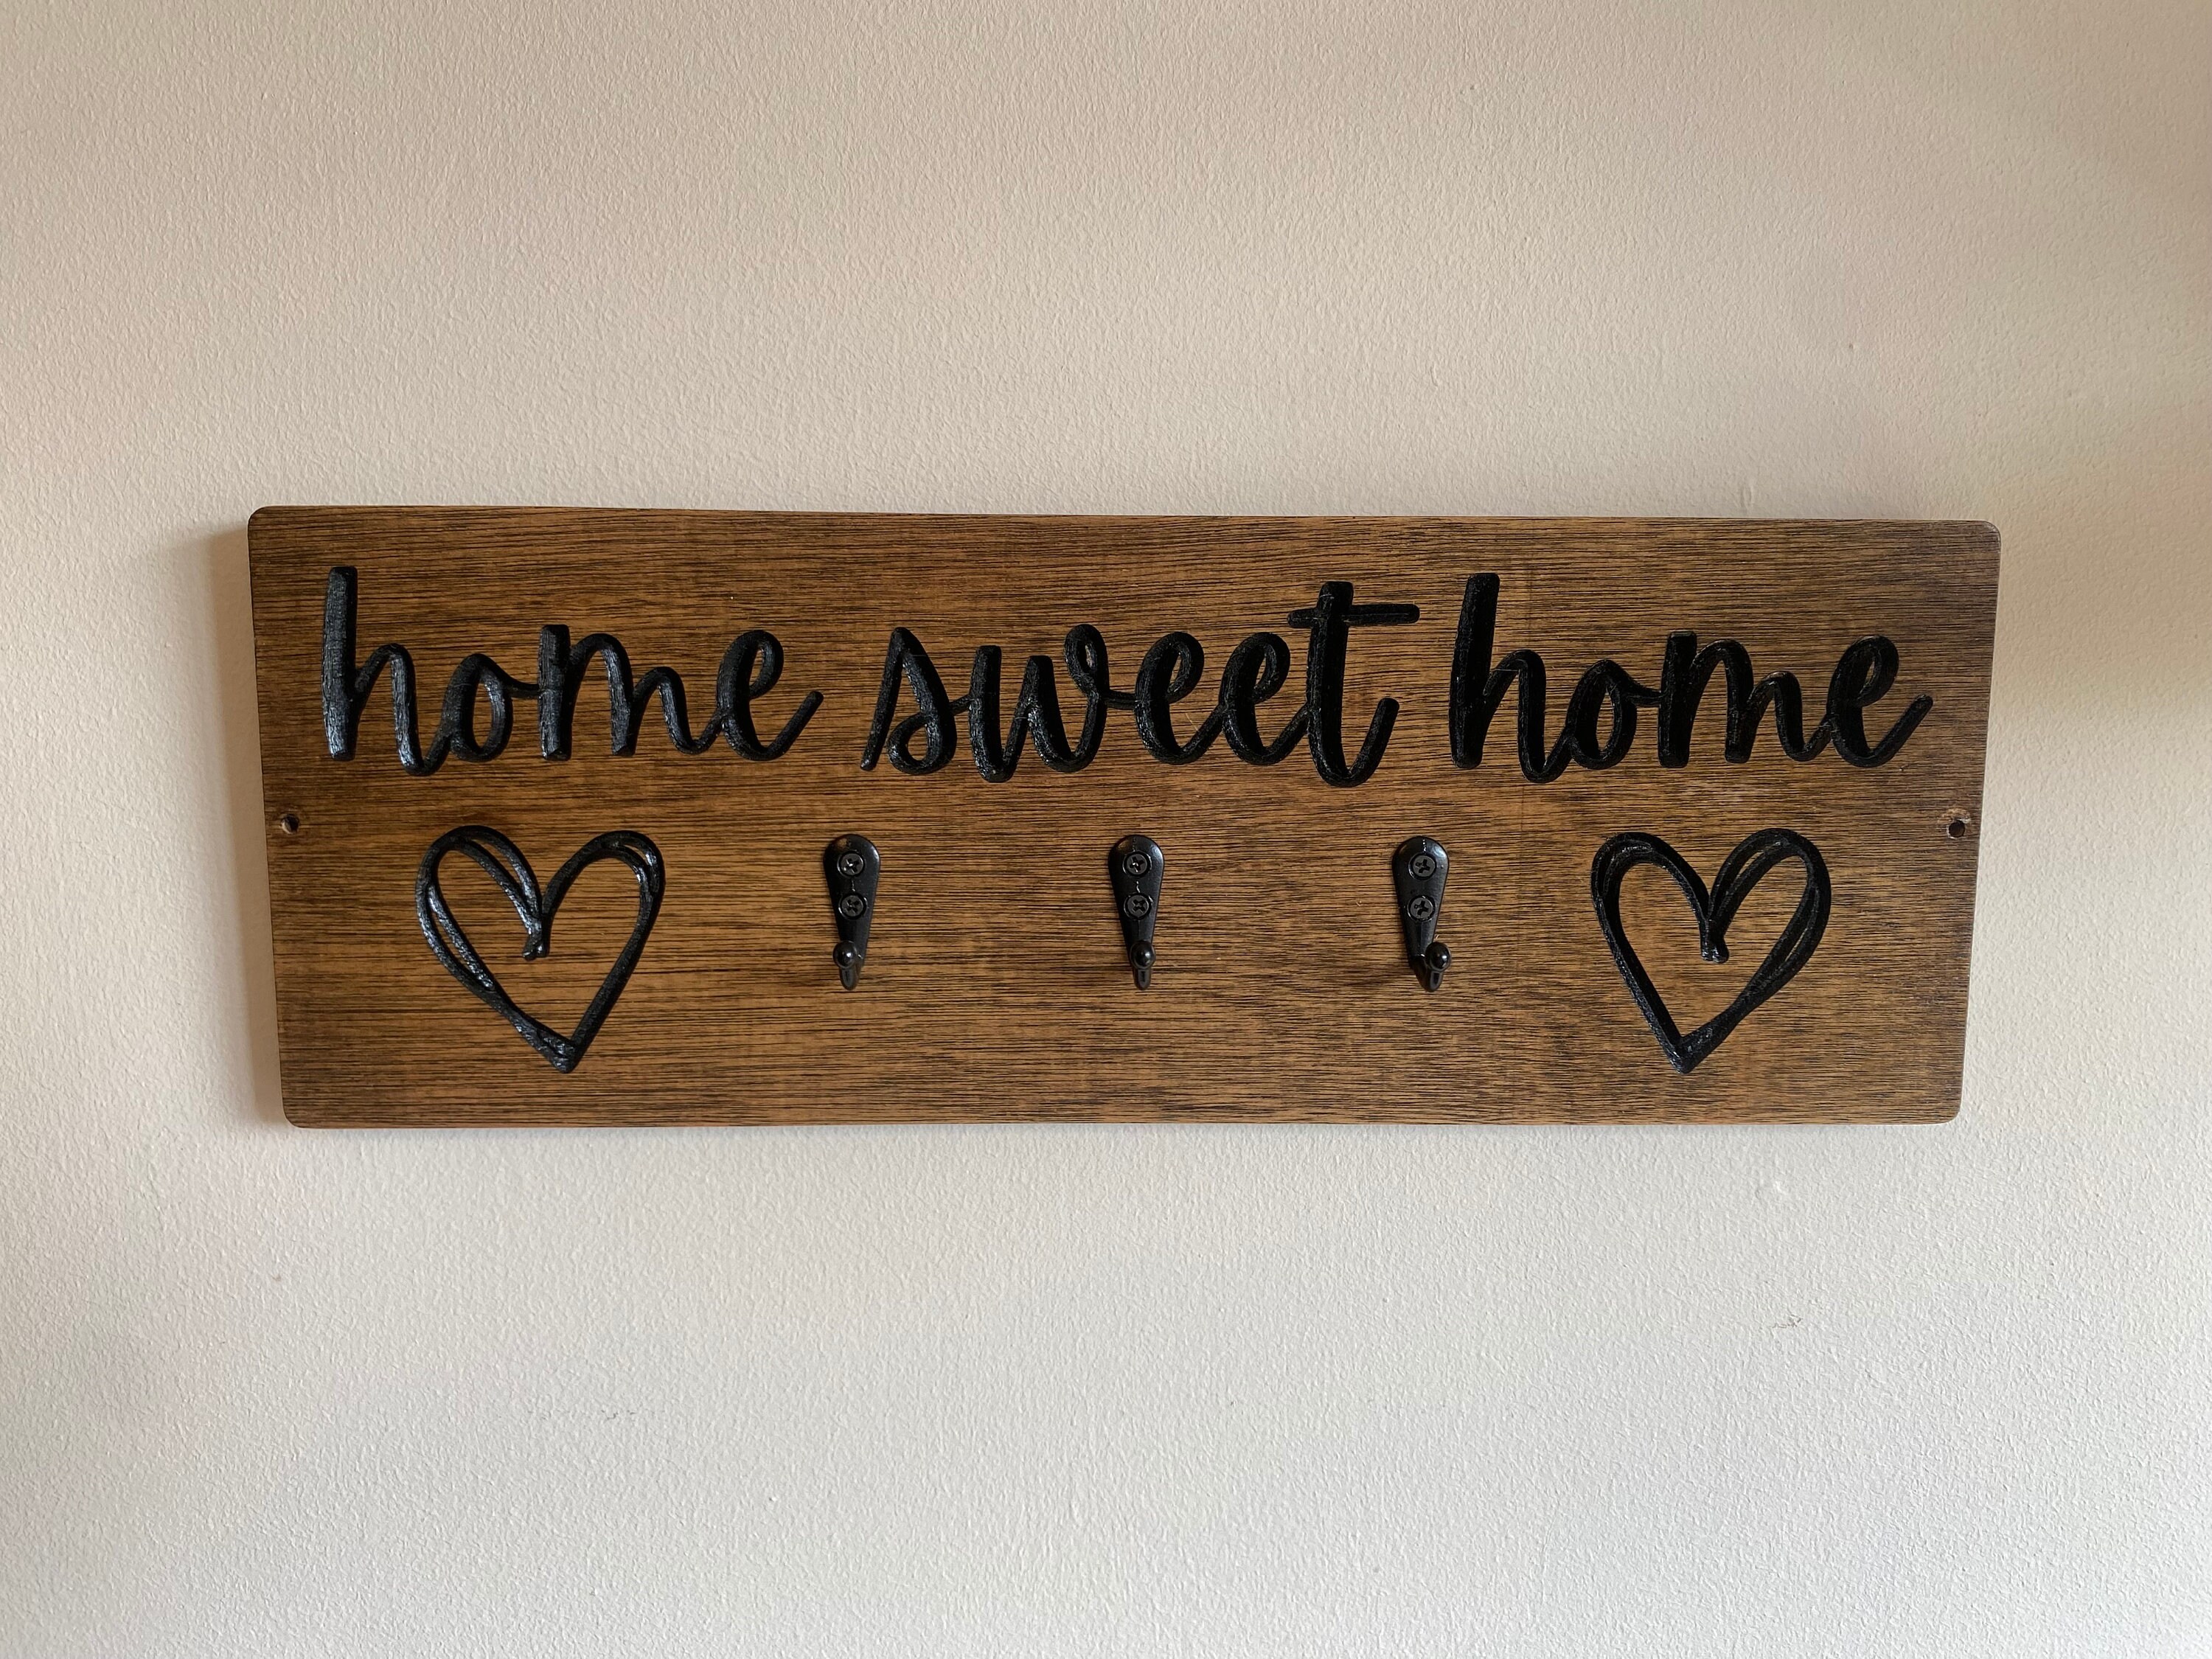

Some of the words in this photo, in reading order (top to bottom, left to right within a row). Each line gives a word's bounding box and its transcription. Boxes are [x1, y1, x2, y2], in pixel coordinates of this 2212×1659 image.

[322, 566, 824, 776] home
[860, 580, 1420, 787] sweet
[1449, 572, 1933, 784] home
